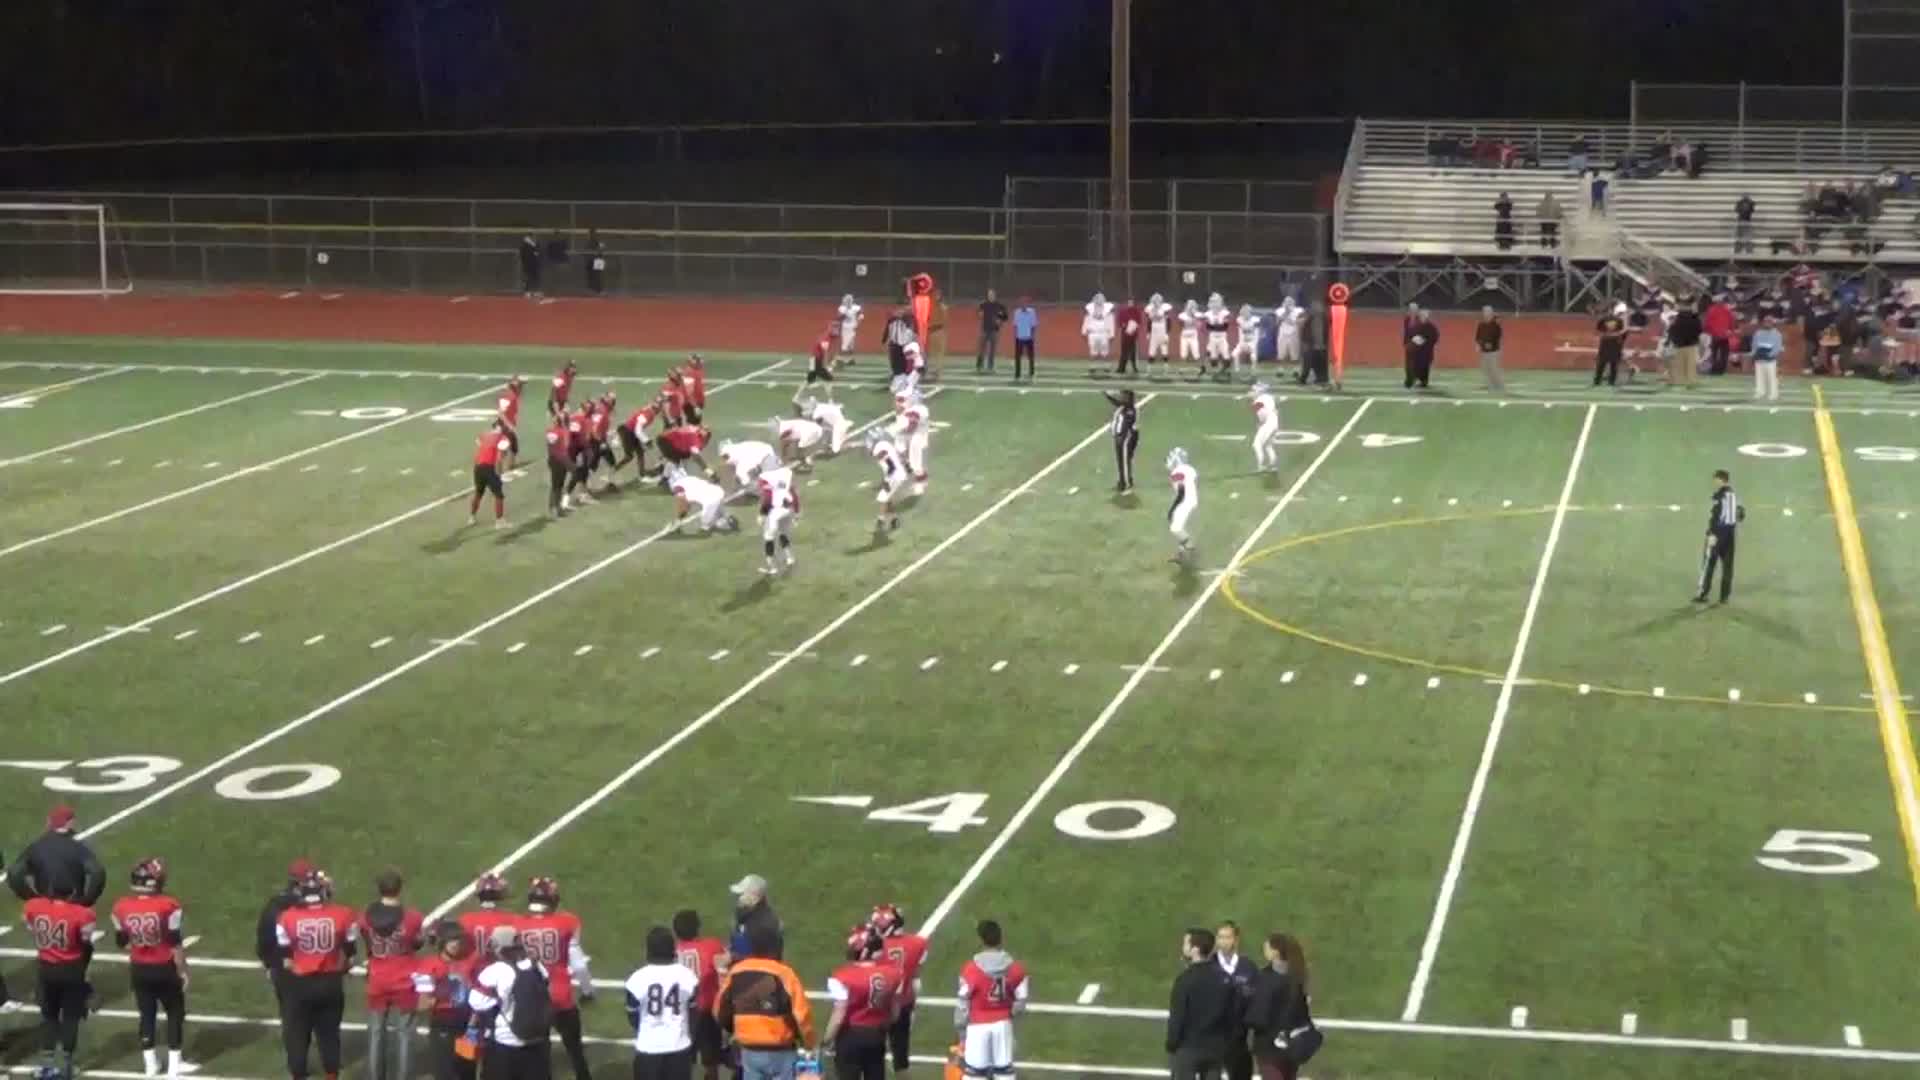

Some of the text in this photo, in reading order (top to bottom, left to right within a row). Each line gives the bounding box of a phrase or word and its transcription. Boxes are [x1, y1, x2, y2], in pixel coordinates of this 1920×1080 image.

[1755, 830, 1880, 874] 5
[296, 917, 335, 954] 50
[521, 926, 559, 964] 58
[647, 982, 681, 1017] 84
